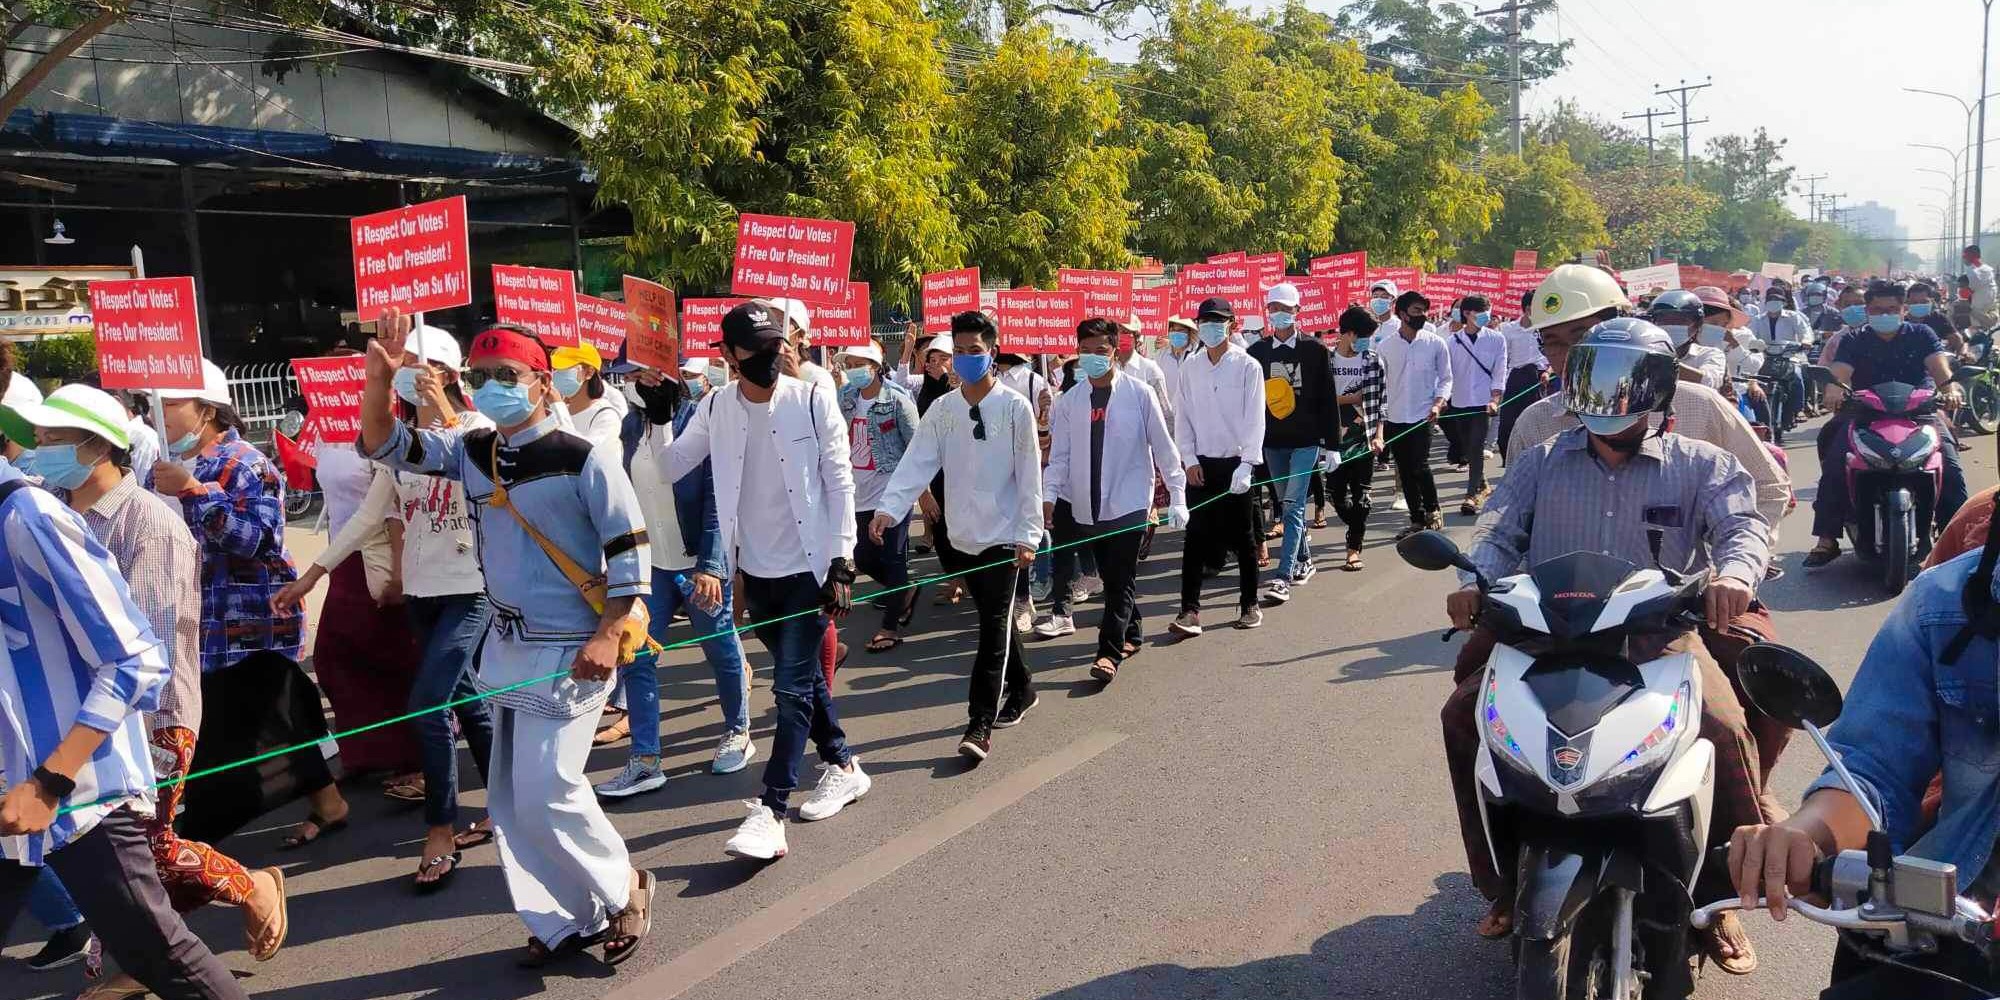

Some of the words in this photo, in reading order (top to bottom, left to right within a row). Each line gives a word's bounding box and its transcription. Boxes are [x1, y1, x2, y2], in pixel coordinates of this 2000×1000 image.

[364, 220, 400, 246] Respect
[400, 218, 416, 238] Our
[417, 213, 444, 234] Votes
[752, 222, 787, 240] Respect
[788, 224, 804, 240] Our
[806, 226, 832, 243] Votes
[367, 256, 386, 276] Free
[388, 252, 404, 272] Our
[404, 242, 446, 268] President
[748, 245, 768, 261] Free
[770, 247, 786, 262] Our
[787, 248, 830, 267] President
[501, 272, 527, 290] Respect
[527, 274, 539, 288] Our
[539, 276, 559, 291] Votes
[1066, 274, 1089, 286] Respect
[1090, 276, 1101, 285] Our
[1102, 276, 1119, 286] Votes
[1192, 270, 1215, 280] Respect
[1216, 268, 1227, 278] Our
[1228, 268, 1246, 278] Votes
[369, 286, 389, 306] Free
[391, 284, 412, 304] Aung
[413, 278, 430, 298] San
[431, 274, 443, 295] Su
[444, 271, 460, 296] Kyi
[745, 269, 765, 284] Free
[766, 270, 788, 290] Aung
[790, 273, 808, 288] San
[810, 275, 822, 290] Su
[824, 277, 839, 296] Kyi
[1191, 285, 1204, 294] Free
[1206, 284, 1216, 294] Our
[1218, 284, 1246, 294] President
[1090, 291, 1118, 302] President
[1304, 288, 1320, 297] Votes
[100, 290, 132, 314] Respect
[132, 289, 148, 308] Our
[148, 288, 173, 308] Votes
[504, 294, 518, 310] Free
[518, 296, 530, 310] Our
[530, 297, 562, 314] President
[1007, 298, 1034, 311] Respect
[1036, 298, 1048, 309] Our
[1049, 298, 1069, 309] Votes
[595, 304, 609, 315] Our
[610, 307, 626, 320] Vote
[692, 304, 718, 317] Respect
[816, 307, 852, 319] President
[1094, 306, 1105, 316] San
[1106, 306, 1114, 316] Su
[1115, 307, 1125, 319] Kyi
[538, 320, 551, 334] San
[551, 321, 560, 336] Su
[560, 322, 572, 340] Kyi
[580, 318, 593, 329] Our
[594, 320, 626, 338] President
[692, 322, 706, 332] Free
[708, 322, 720, 332] Our
[1008, 316, 1023, 327] Free
[1024, 316, 1037, 327] Our
[1038, 316, 1070, 328] President
[104, 322, 122, 342] Free
[122, 322, 137, 342] Our
[138, 321, 179, 342] President
[823, 326, 838, 338] San
[839, 326, 848, 338] Su
[850, 326, 862, 340] Kyi
[692, 339, 706, 350] Free
[1008, 334, 1024, 345] Free
[1026, 334, 1043, 348] Aung
[1044, 334, 1057, 346] San
[1058, 334, 1067, 346] Su
[108, 354, 126, 373] Free
[128, 355, 148, 379] Aung
[149, 354, 166, 374] San
[166, 354, 178, 374] Su
[179, 354, 194, 380] Kyi
[307, 366, 349, 386] Respect
[348, 365, 367, 381] Our
[317, 391, 341, 407] Free
[341, 391, 360, 406] Our
[328, 416, 350, 431] Free
